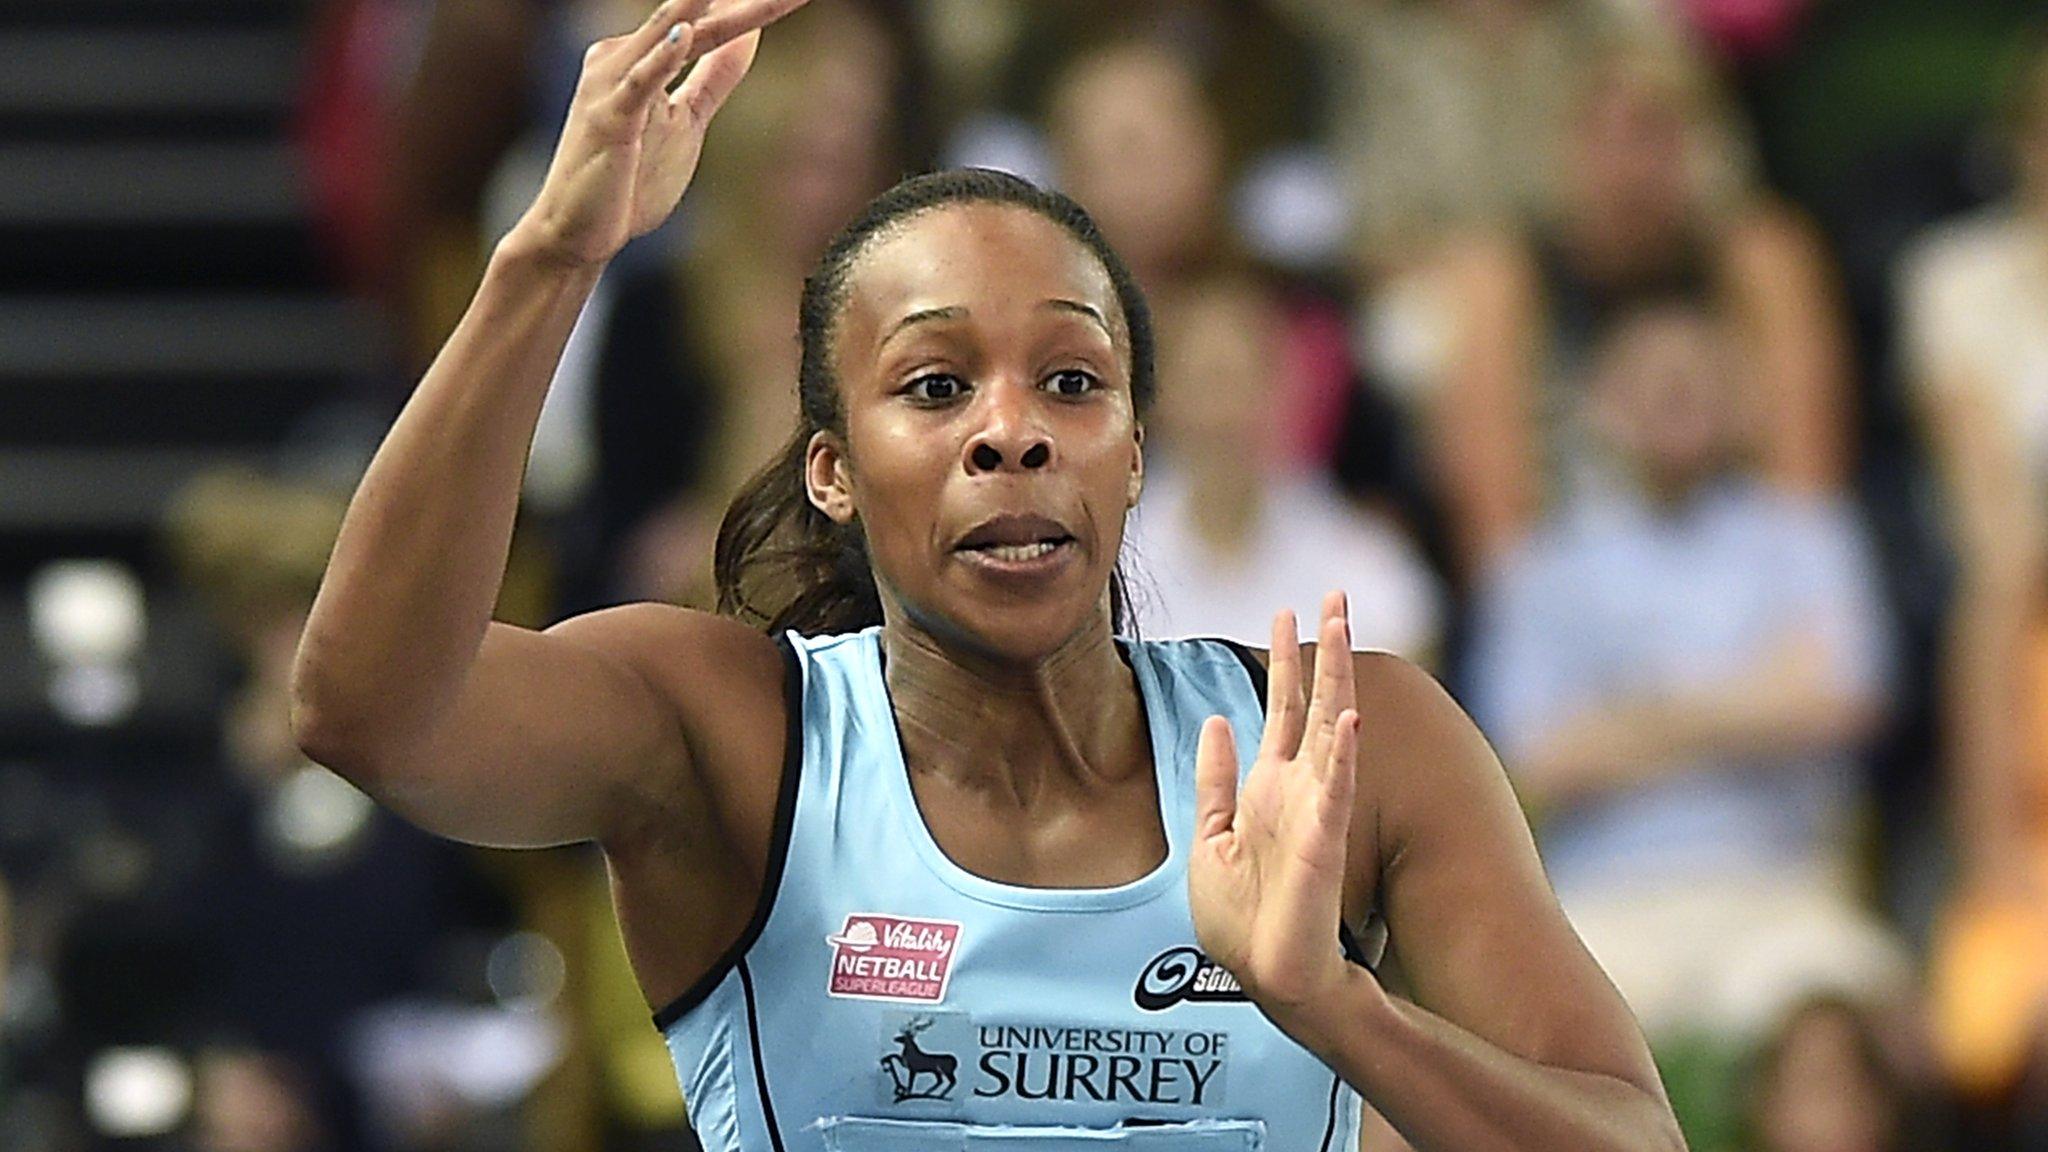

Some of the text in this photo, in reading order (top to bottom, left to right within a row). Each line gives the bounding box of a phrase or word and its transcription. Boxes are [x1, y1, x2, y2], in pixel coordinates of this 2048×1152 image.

[883, 921, 952, 959] Vitality
[837, 955, 942, 981] NETBALL
[835, 977, 939, 997] SUPERLEAGUE
[980, 1026, 1227, 1056] UNIVERSITY OF
[973, 1050, 1222, 1105] SURREY
